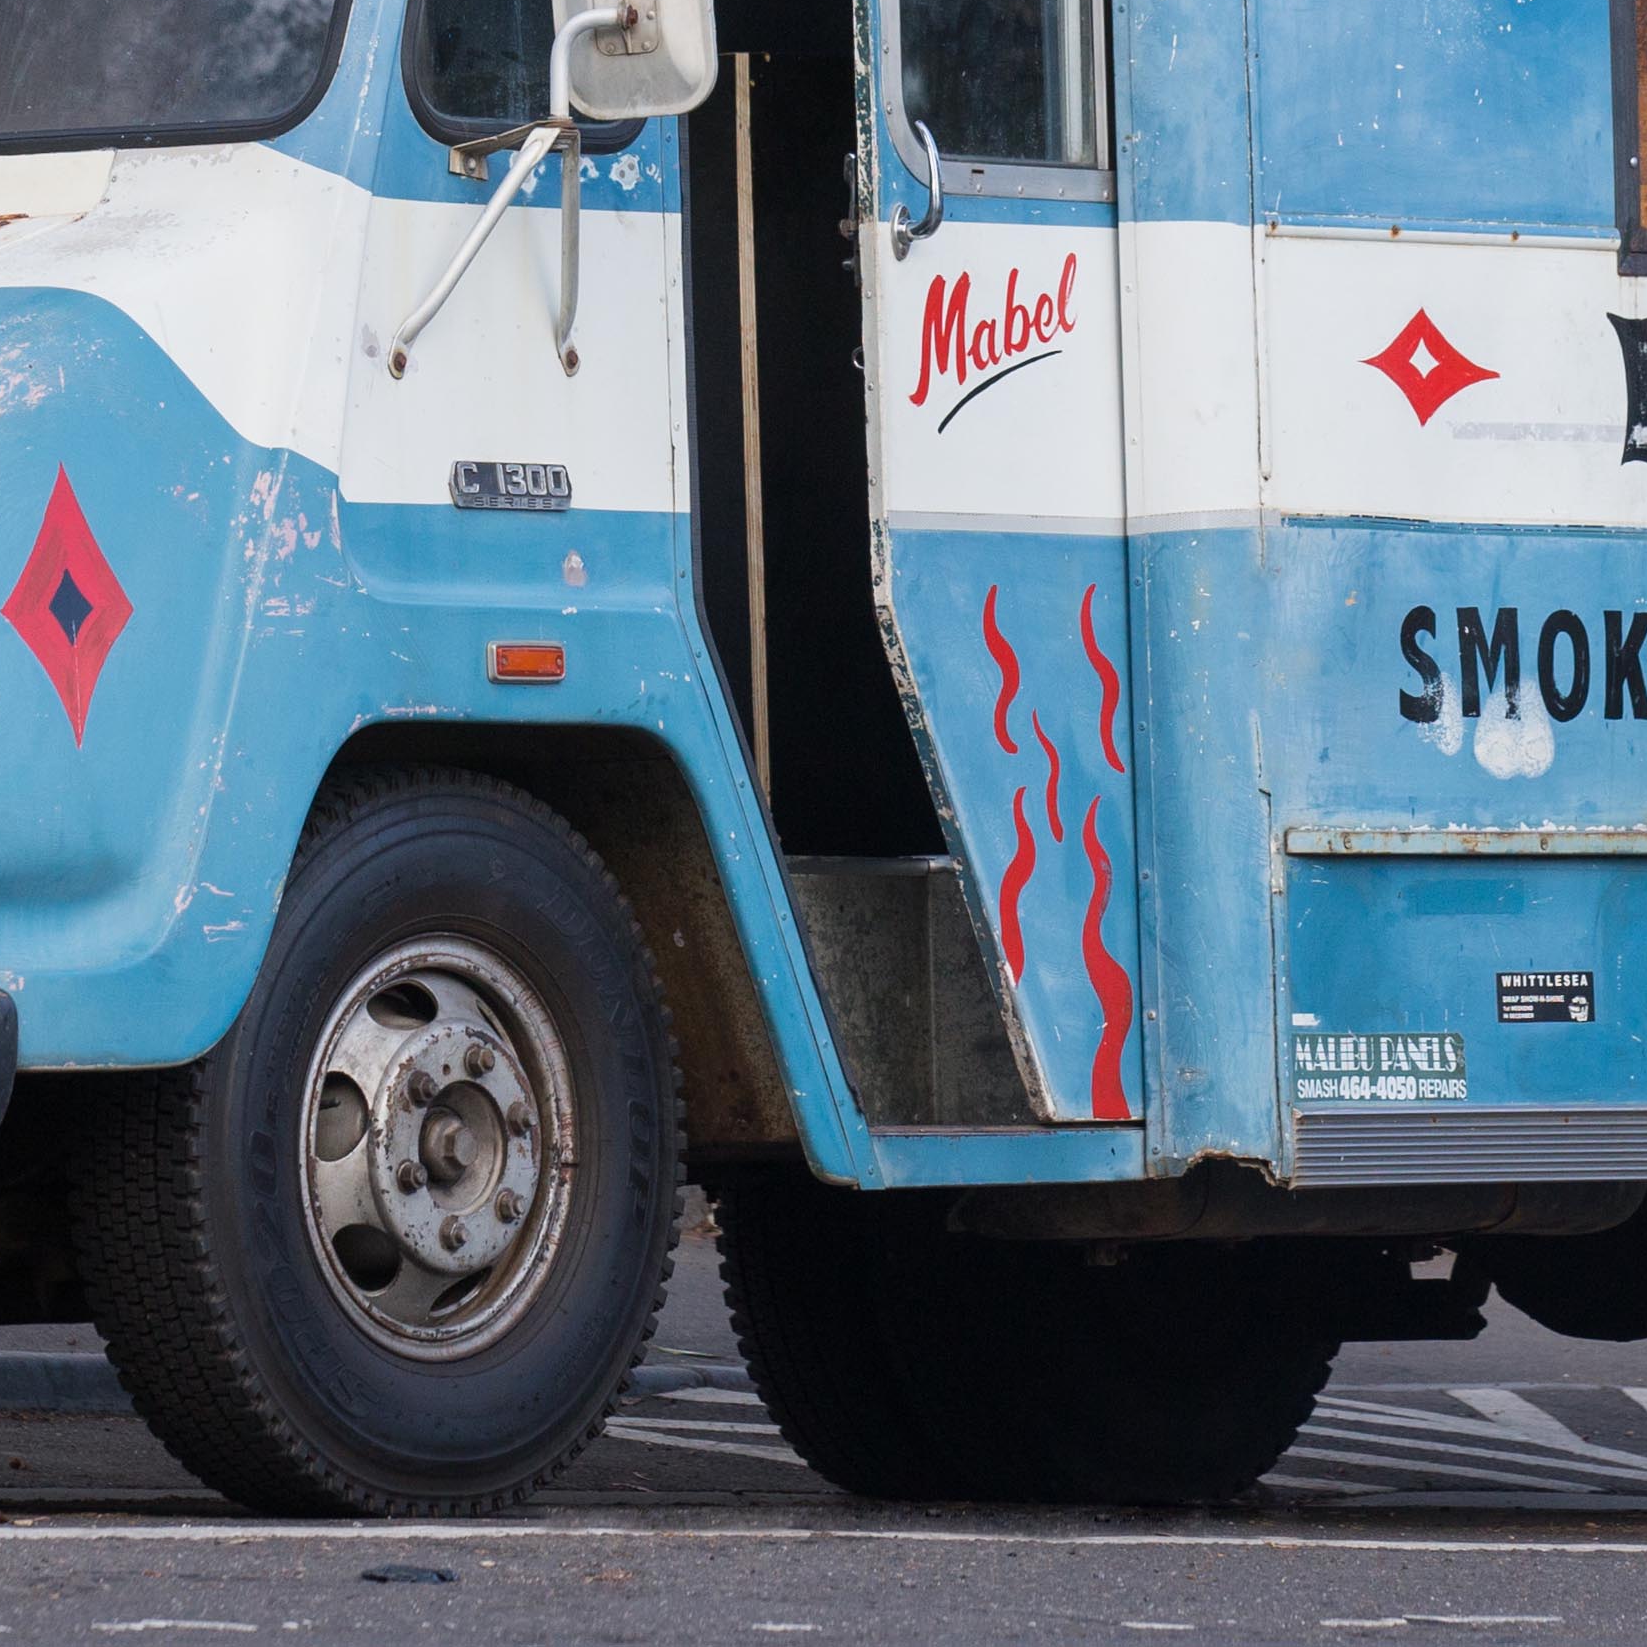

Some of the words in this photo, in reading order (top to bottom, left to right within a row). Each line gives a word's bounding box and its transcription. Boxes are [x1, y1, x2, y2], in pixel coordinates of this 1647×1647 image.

[908, 252, 1078, 407] Mabel
[456, 461, 480, 494] C
[496, 463, 569, 496] 1300
[474, 495, 553, 509] SERIES
[1501, 974, 1589, 988] WHITTLESEA
[1294, 1036, 1375, 1072] MALIBU
[1380, 1036, 1458, 1073] PANELS
[1297, 1078, 1339, 1099] SMASH
[1339, 1075, 1417, 1101] 464-4050
[1418, 1078, 1468, 1099] REPAIRS
